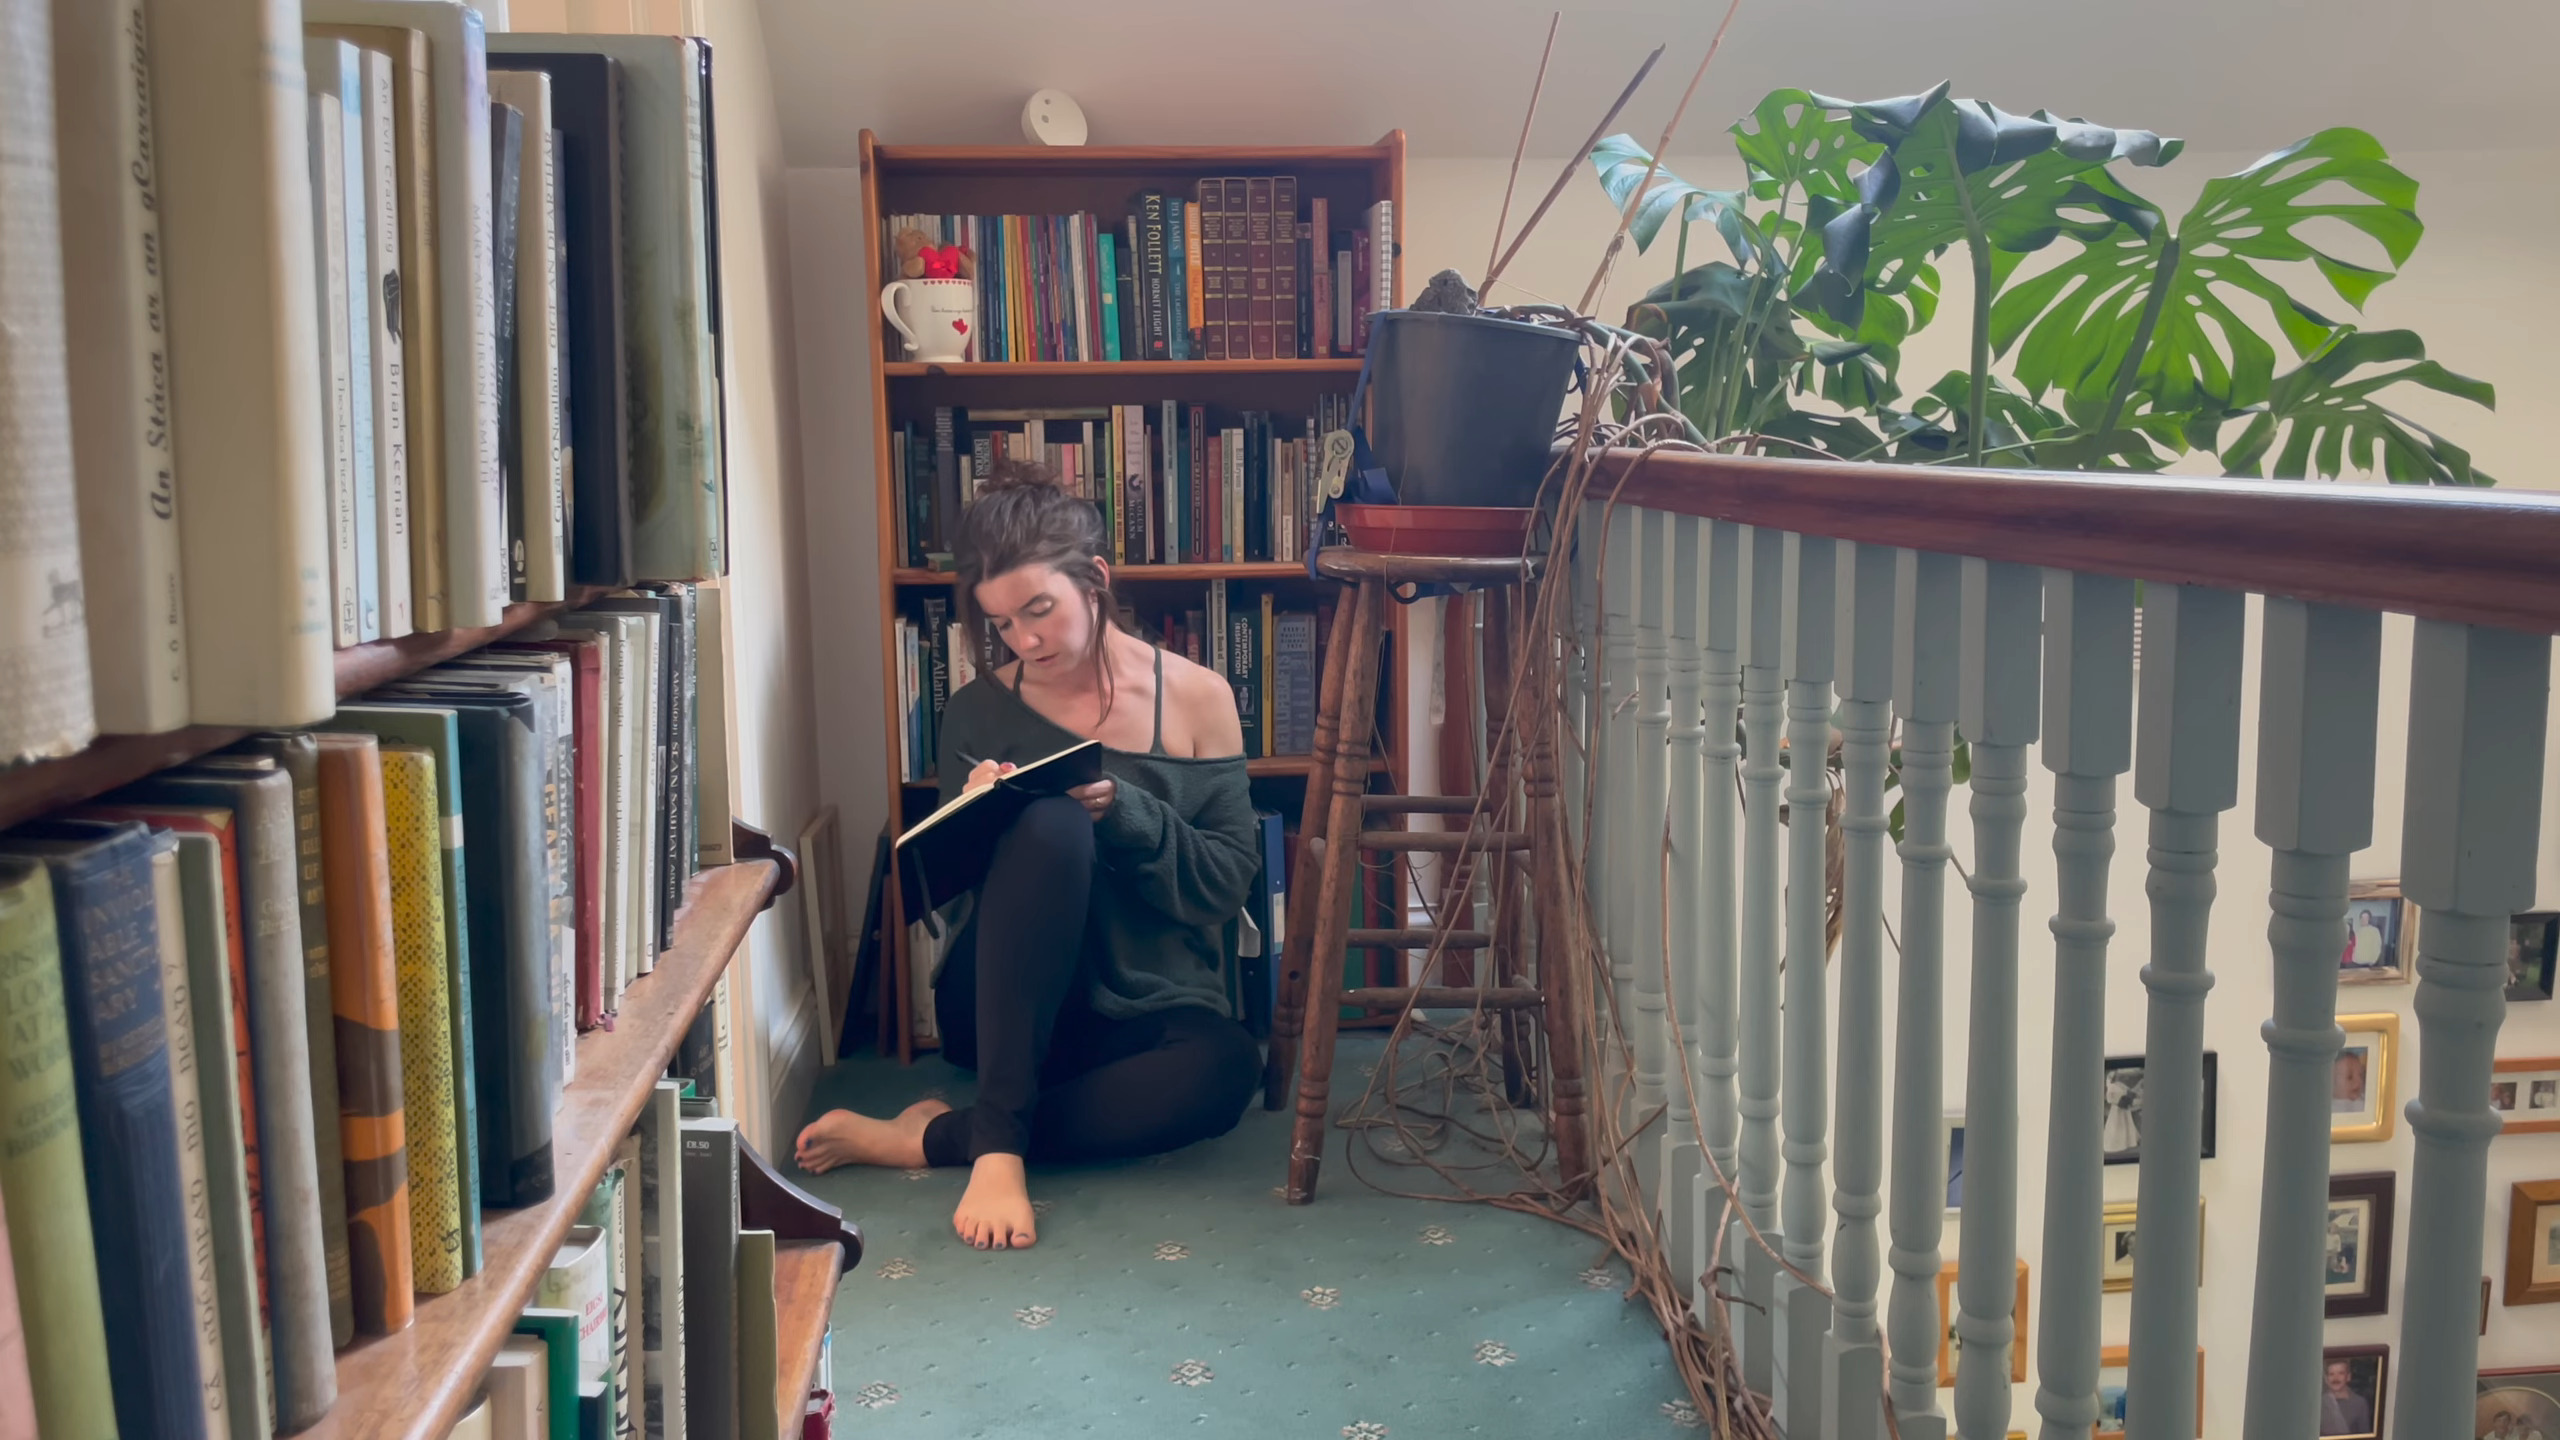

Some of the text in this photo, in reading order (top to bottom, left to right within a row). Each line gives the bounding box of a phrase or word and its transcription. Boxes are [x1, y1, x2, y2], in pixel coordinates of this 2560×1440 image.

[380, 79, 395, 254] An Evil Cradling
[144, 232, 157, 277] an
[1146, 194, 1162, 275] KEN FOLLETT
[1170, 220, 1181, 250] JAMES
[503, 247, 516, 340] NEWTON
[1151, 278, 1162, 336] HORNET FLIGHT
[146, 352, 170, 452] Stáca
[390, 364, 404, 536] Brian Keenan
[974, 439, 983, 477] EMOTIONS
[151, 470, 173, 520] An
[931, 616, 940, 631] The
[932, 633, 941, 648] End
[1241, 617, 1249, 680] CONTEMPORARY
[933, 659, 948, 713] Atlantis
